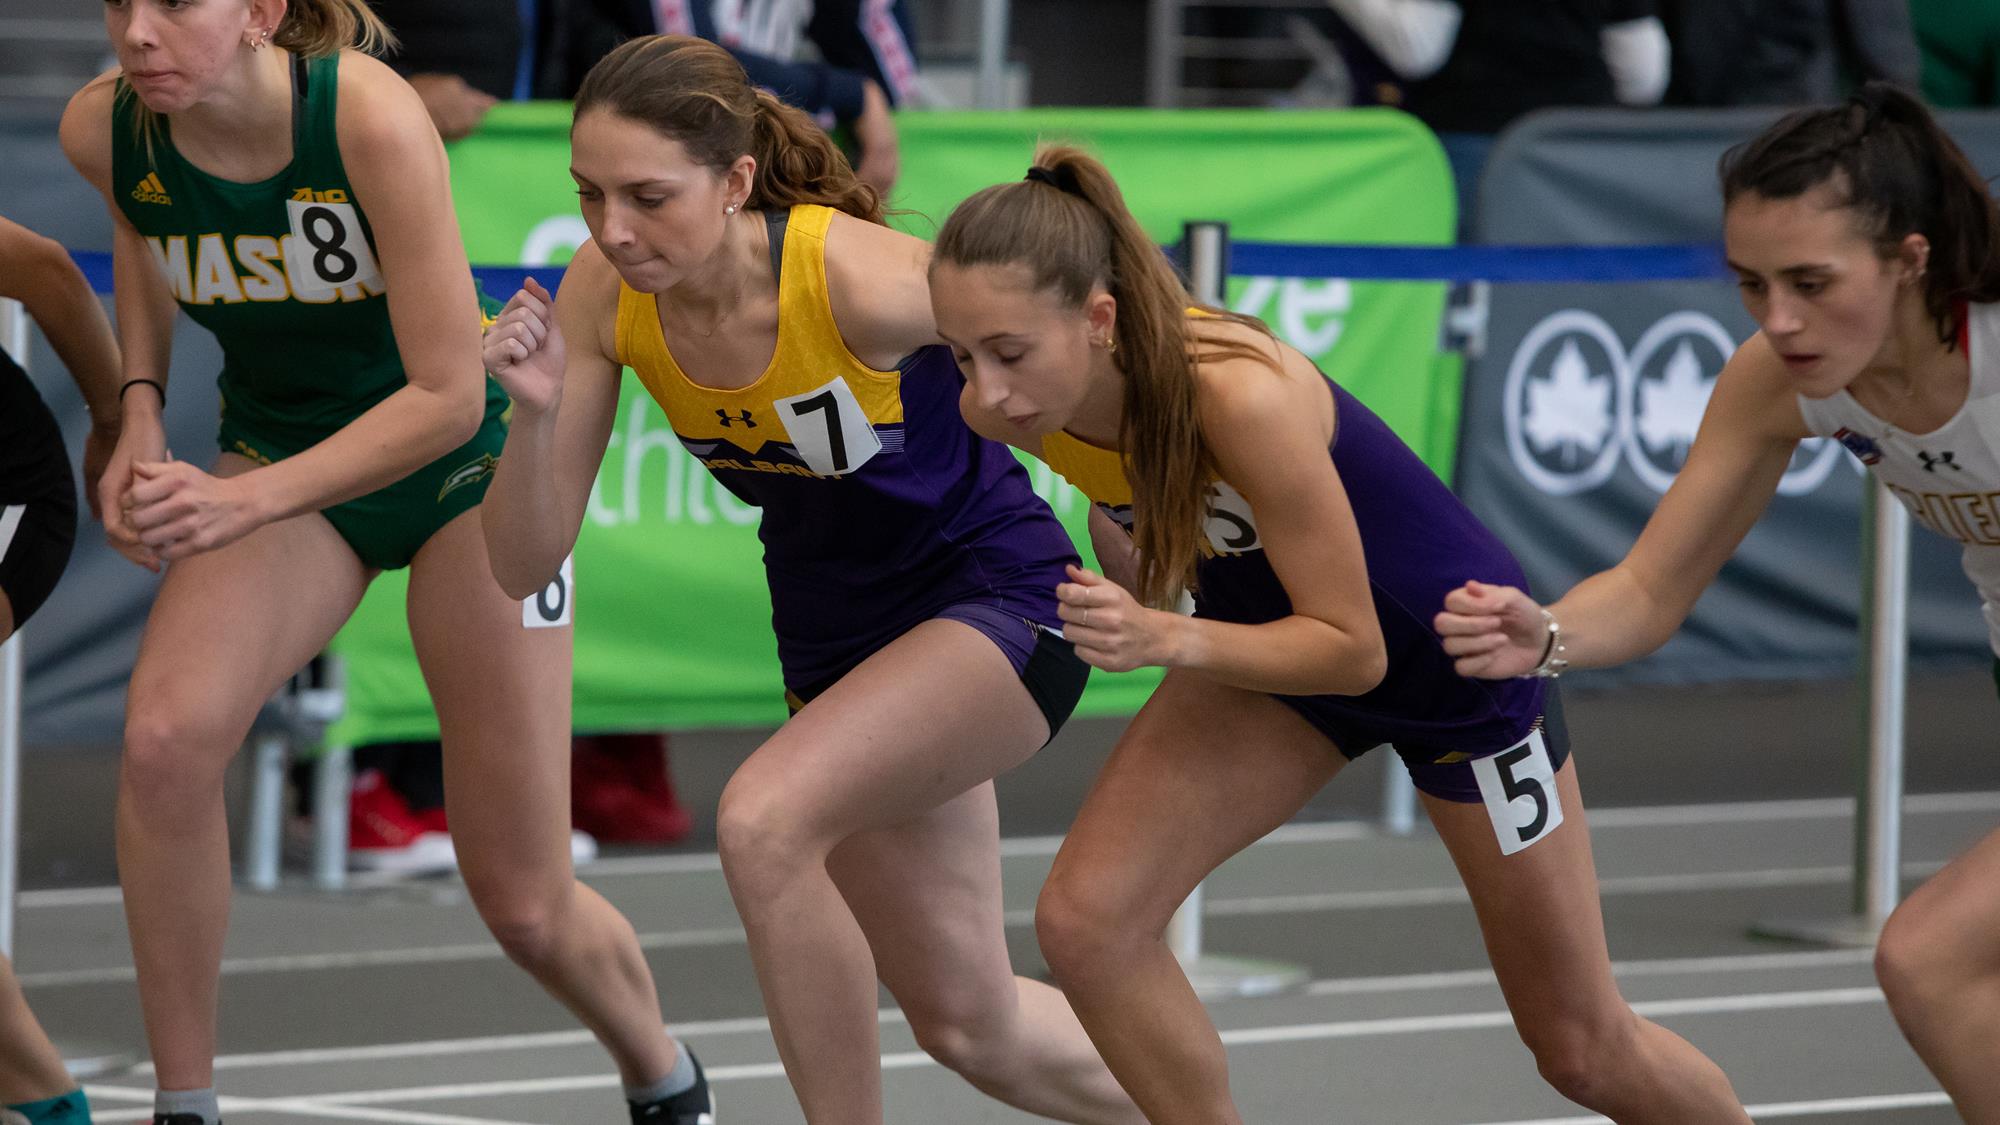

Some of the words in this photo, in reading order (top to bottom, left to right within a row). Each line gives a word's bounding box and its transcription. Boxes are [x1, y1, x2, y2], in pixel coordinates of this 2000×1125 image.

[302, 206, 357, 283] 8
[790, 389, 849, 472] 7
[1494, 742, 1549, 842] 5
